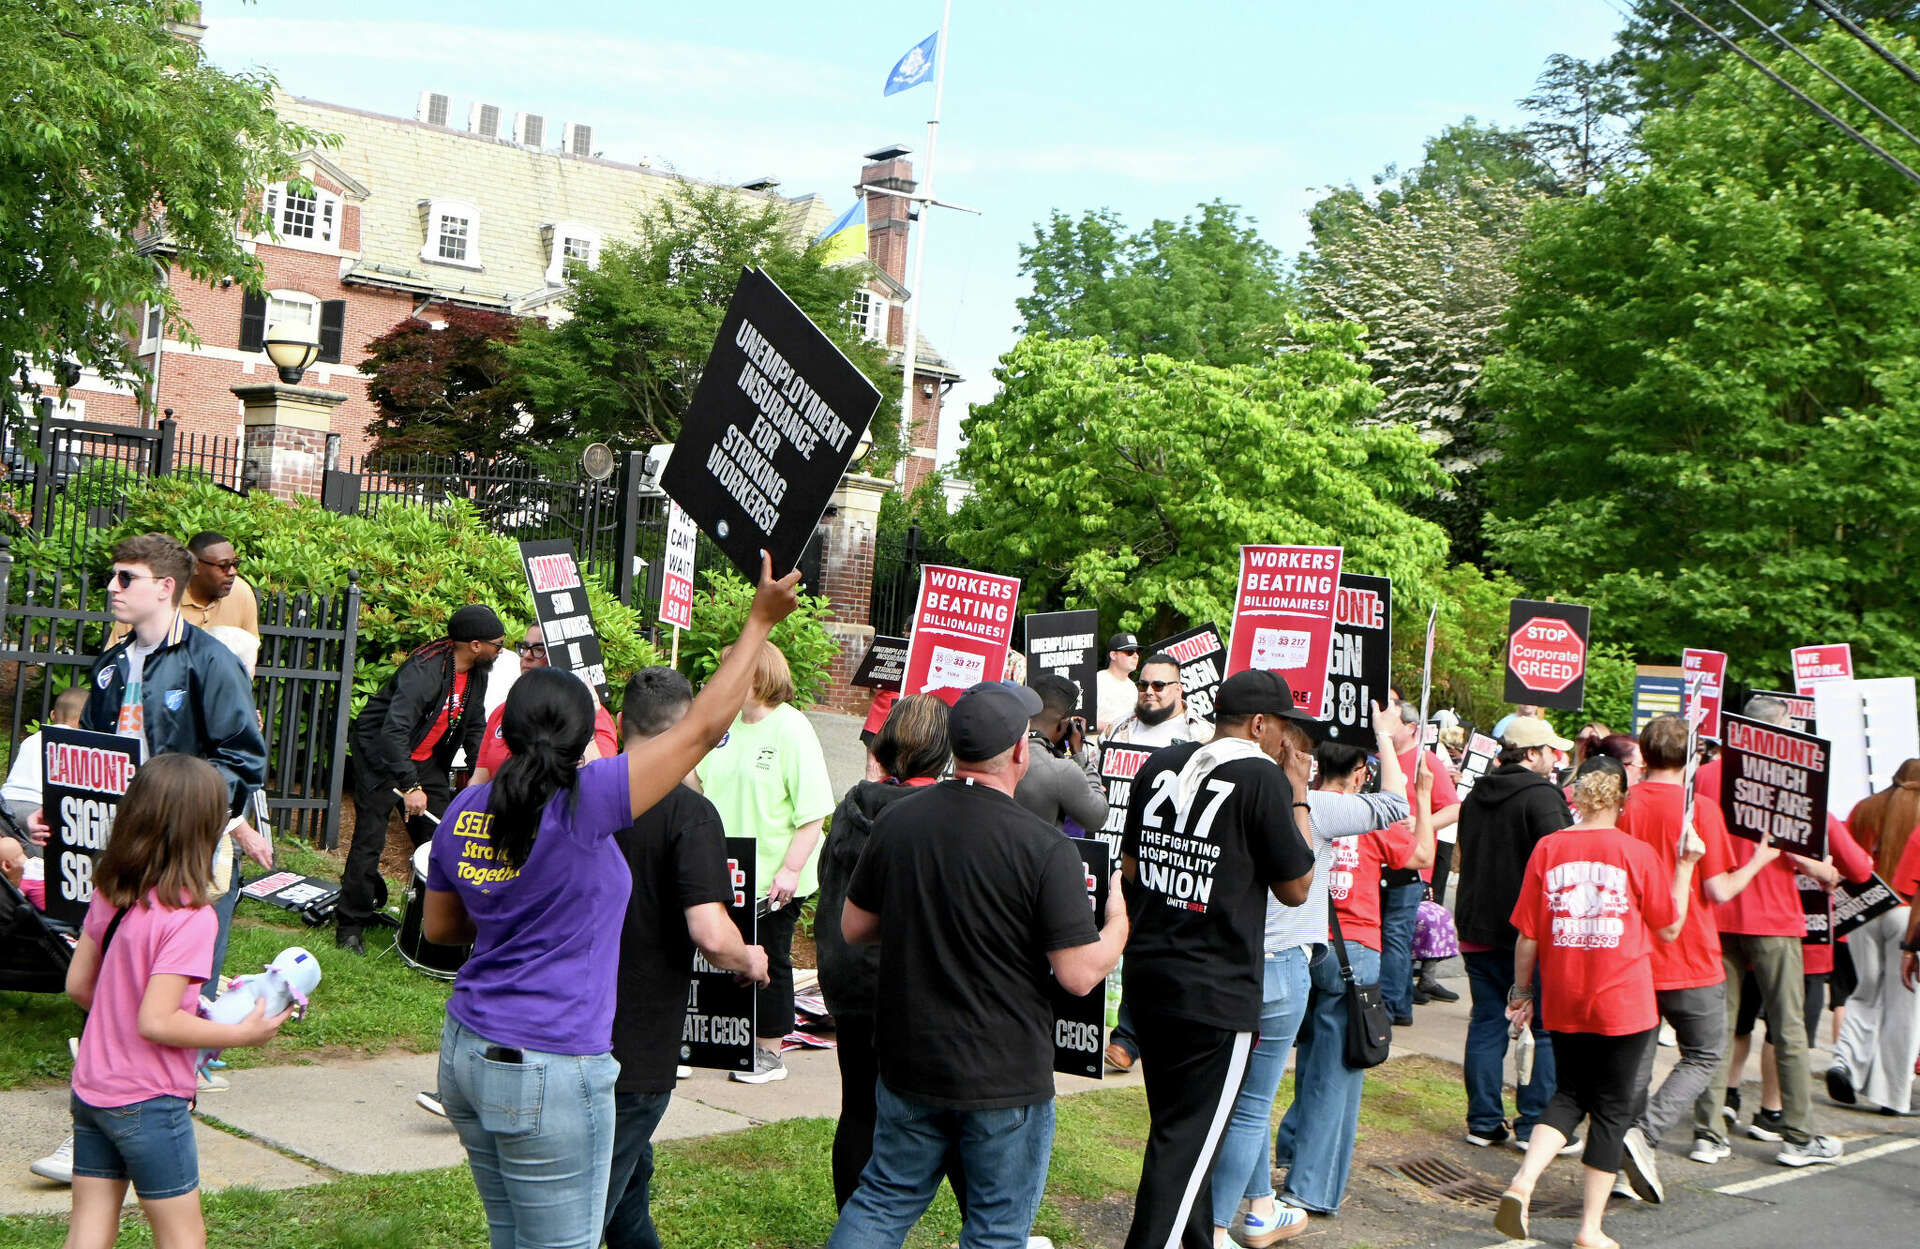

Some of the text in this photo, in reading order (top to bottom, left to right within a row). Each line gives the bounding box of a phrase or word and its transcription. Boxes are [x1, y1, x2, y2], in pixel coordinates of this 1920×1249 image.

[735, 318, 852, 453] UNEMPLOYMENT
[737, 361, 820, 461] INSURANCE
[749, 413, 781, 461] FOR
[722, 424, 788, 507] STRIKING
[706, 443, 781, 537] WORKERS!
[670, 529, 695, 554] CAN'T
[1250, 551, 1335, 570] WORKERS
[669, 577, 690, 602] PASS
[930, 571, 1013, 600] WORKERS
[1247, 573, 1332, 594] BEATING
[667, 599, 679, 619] SB
[926, 591, 1008, 622] BEATING
[1243, 595, 1330, 611] BILLIONAIRES!
[1336, 587, 1385, 630] ONT:
[923, 612, 1005, 639] BILLIONAIRES!
[1527, 626, 1568, 642] STOP
[1031, 633, 1094, 654] UNEMPLOYMENT
[1291, 638, 1306, 646] 217
[1328, 631, 1363, 678] GN
[1513, 644, 1579, 662] Corporate
[966, 660, 981, 668] 217
[1040, 649, 1083, 668] INSURANCE
[1517, 660, 1573, 680] GREED
[1685, 655, 1704, 669] WE
[1797, 652, 1821, 664] WE
[1180, 657, 1220, 693] SIGN
[1727, 721, 1825, 772] LAMONT:
[1741, 754, 1808, 794] WHICH
[1734, 777, 1813, 821] SIDE ARE
[1732, 801, 1813, 845] YOU ON?
[457, 861, 521, 886] Togeth
[1139, 845, 1217, 875] HOSPITALITY
[1139, 861, 1214, 904] UNION
[1552, 917, 1624, 936] PROUD
[711, 1015, 750, 1046] CEOS
[1055, 1018, 1099, 1053] CEOS
